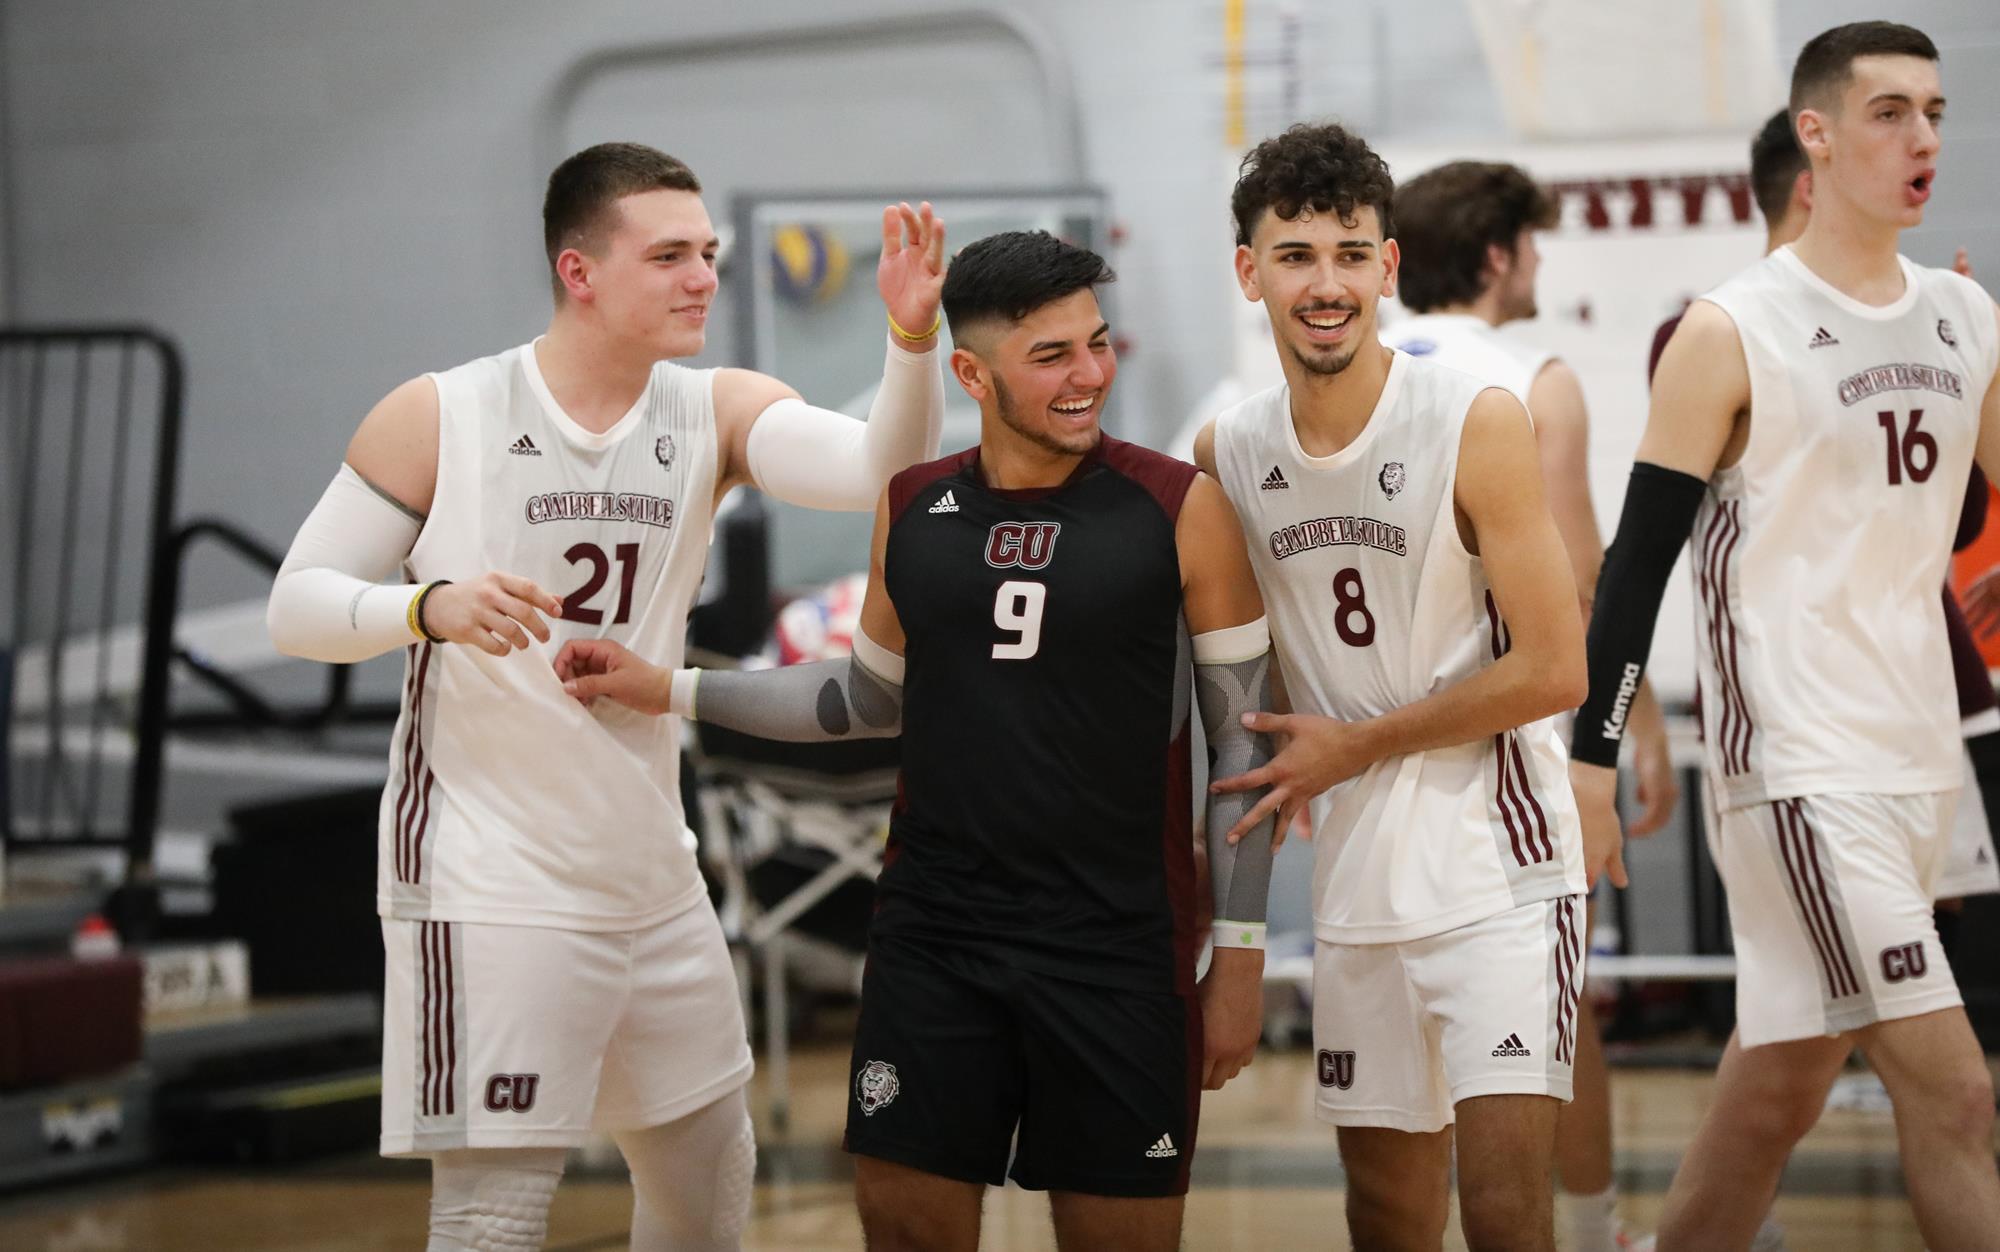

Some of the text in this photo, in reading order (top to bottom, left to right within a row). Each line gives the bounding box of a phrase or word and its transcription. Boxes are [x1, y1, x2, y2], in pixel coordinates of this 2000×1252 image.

[1877, 409, 1938, 485] 16
[1261, 480, 1289, 490] adidas
[525, 491, 673, 529] CAMPBELLSVILLE
[928, 504, 960, 514] adidas
[984, 521, 1061, 570] CU
[560, 542, 640, 625] 21
[991, 580, 1046, 660] 9
[1333, 567, 1375, 647] 8
[1602, 662, 1641, 740] Kempa
[1879, 940, 1928, 984] CU
[1318, 1048, 1356, 1090] CU
[1492, 1048, 1531, 1057] adidas
[484, 1073, 539, 1113] CU
[1145, 1148, 1177, 1158] adidas
